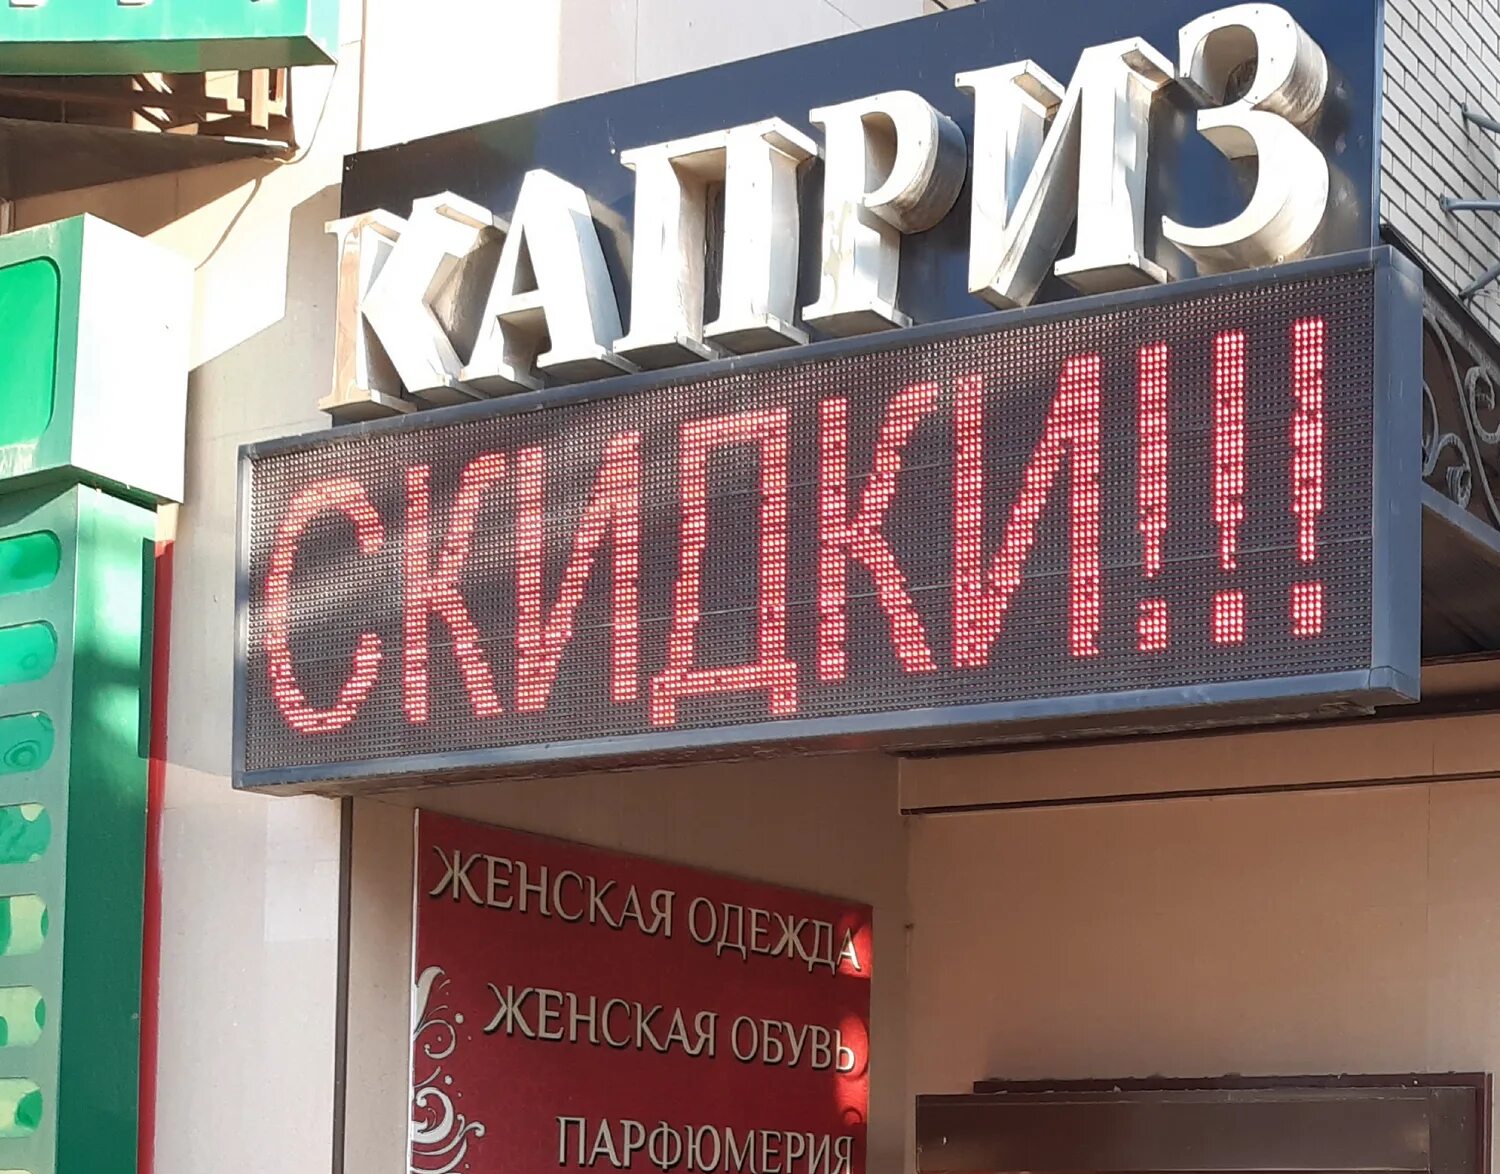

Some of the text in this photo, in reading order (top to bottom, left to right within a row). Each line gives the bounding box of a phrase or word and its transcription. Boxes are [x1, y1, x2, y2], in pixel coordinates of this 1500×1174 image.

[317, 2, 1331, 416] КАПРИЗ
[263, 314, 1328, 737] СКИДКИ!!!
[429, 845, 862, 975] ЖЕНСКАЯ ОДЕЖДА
[483, 982, 856, 1073] ЖЕНСКАЯ ОБУВЬ
